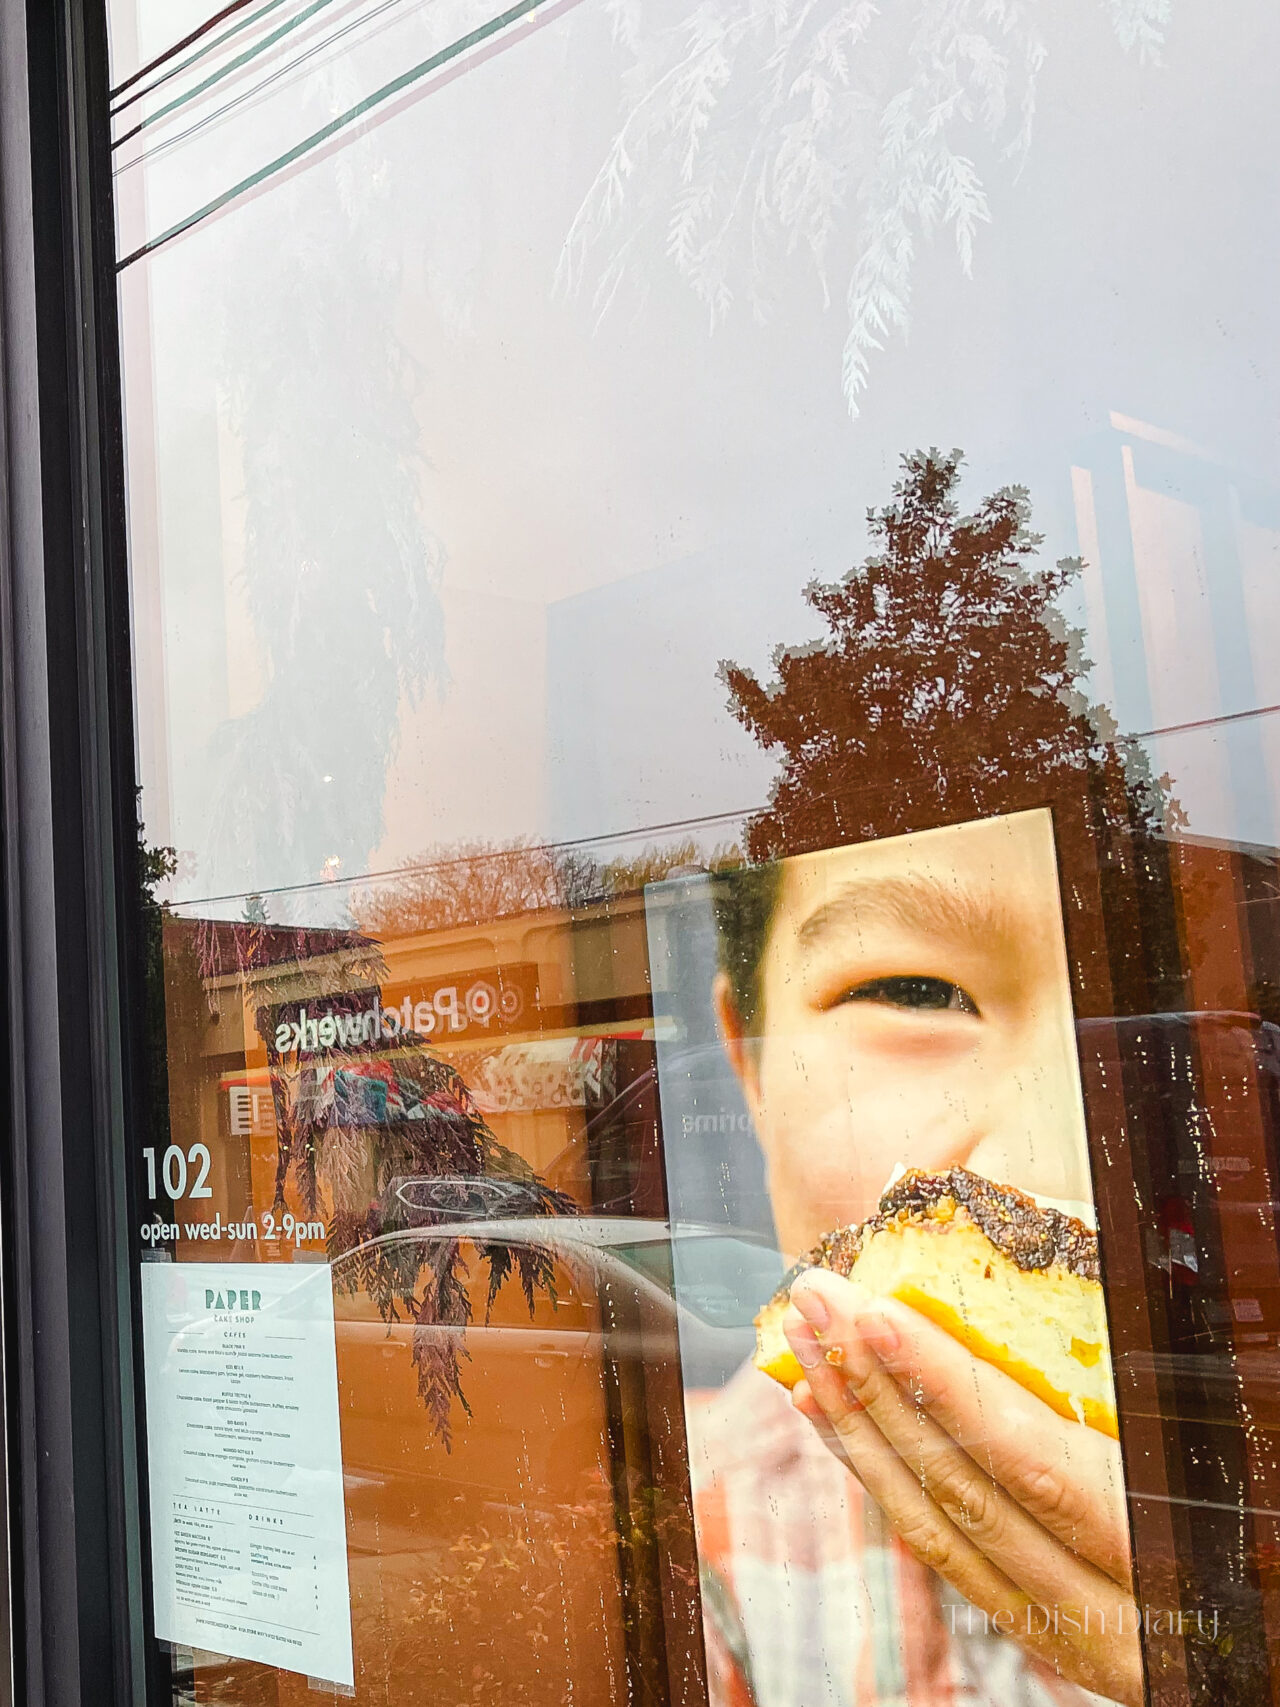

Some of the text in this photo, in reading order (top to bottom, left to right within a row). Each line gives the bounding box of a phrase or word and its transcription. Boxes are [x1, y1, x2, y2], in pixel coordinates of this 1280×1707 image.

[142, 1142, 213, 1200] 102
[140, 1212, 326, 1248] open wed-sun 2-9pm
[205, 1288, 262, 1311] PAPER
[213, 1314, 255, 1324] CAKE SHOP
